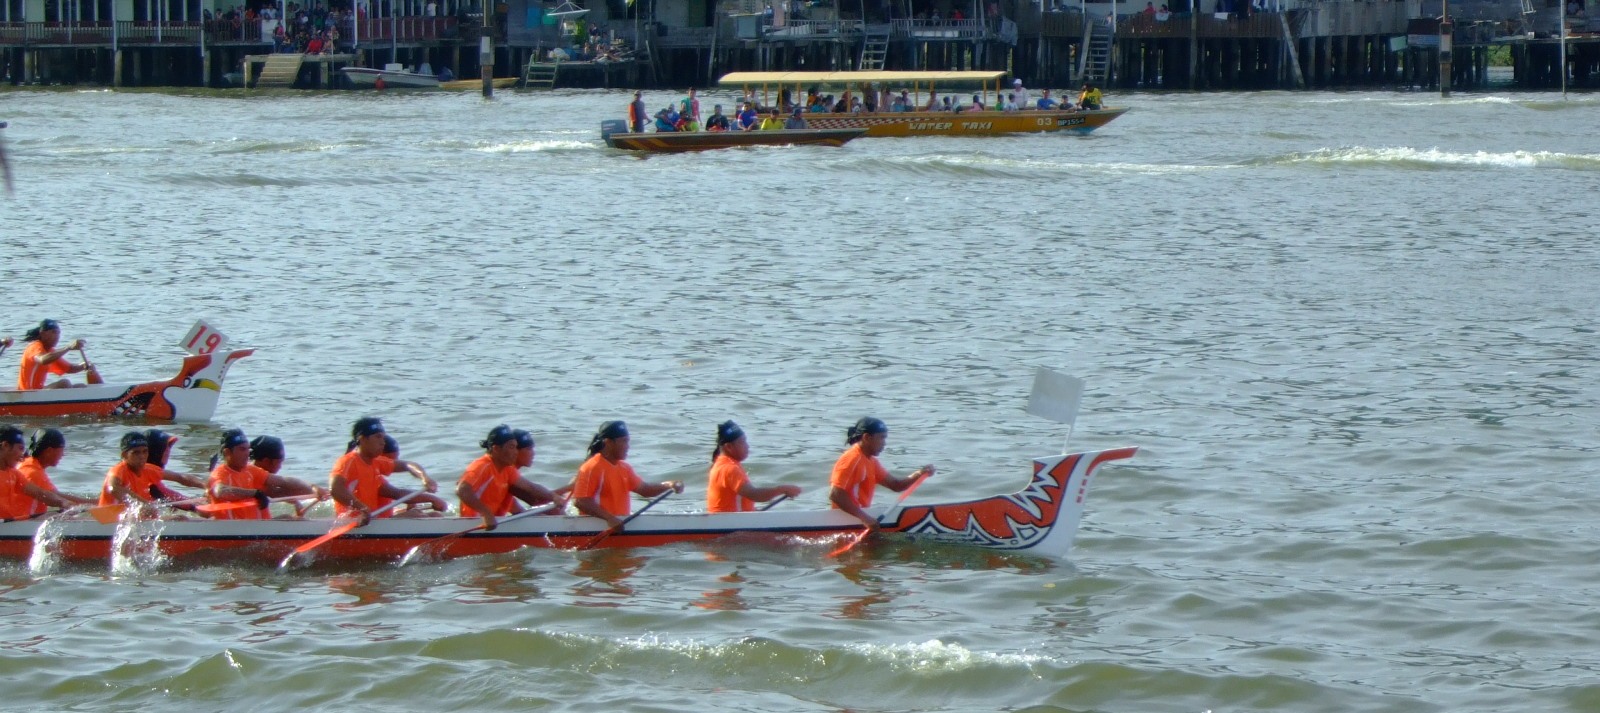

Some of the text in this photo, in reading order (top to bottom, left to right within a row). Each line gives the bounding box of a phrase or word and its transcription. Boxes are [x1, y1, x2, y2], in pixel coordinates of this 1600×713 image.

[909, 121, 993, 130] WATER TAXI
[1037, 117, 1052, 126] 03
[187, 325, 222, 355] 19
